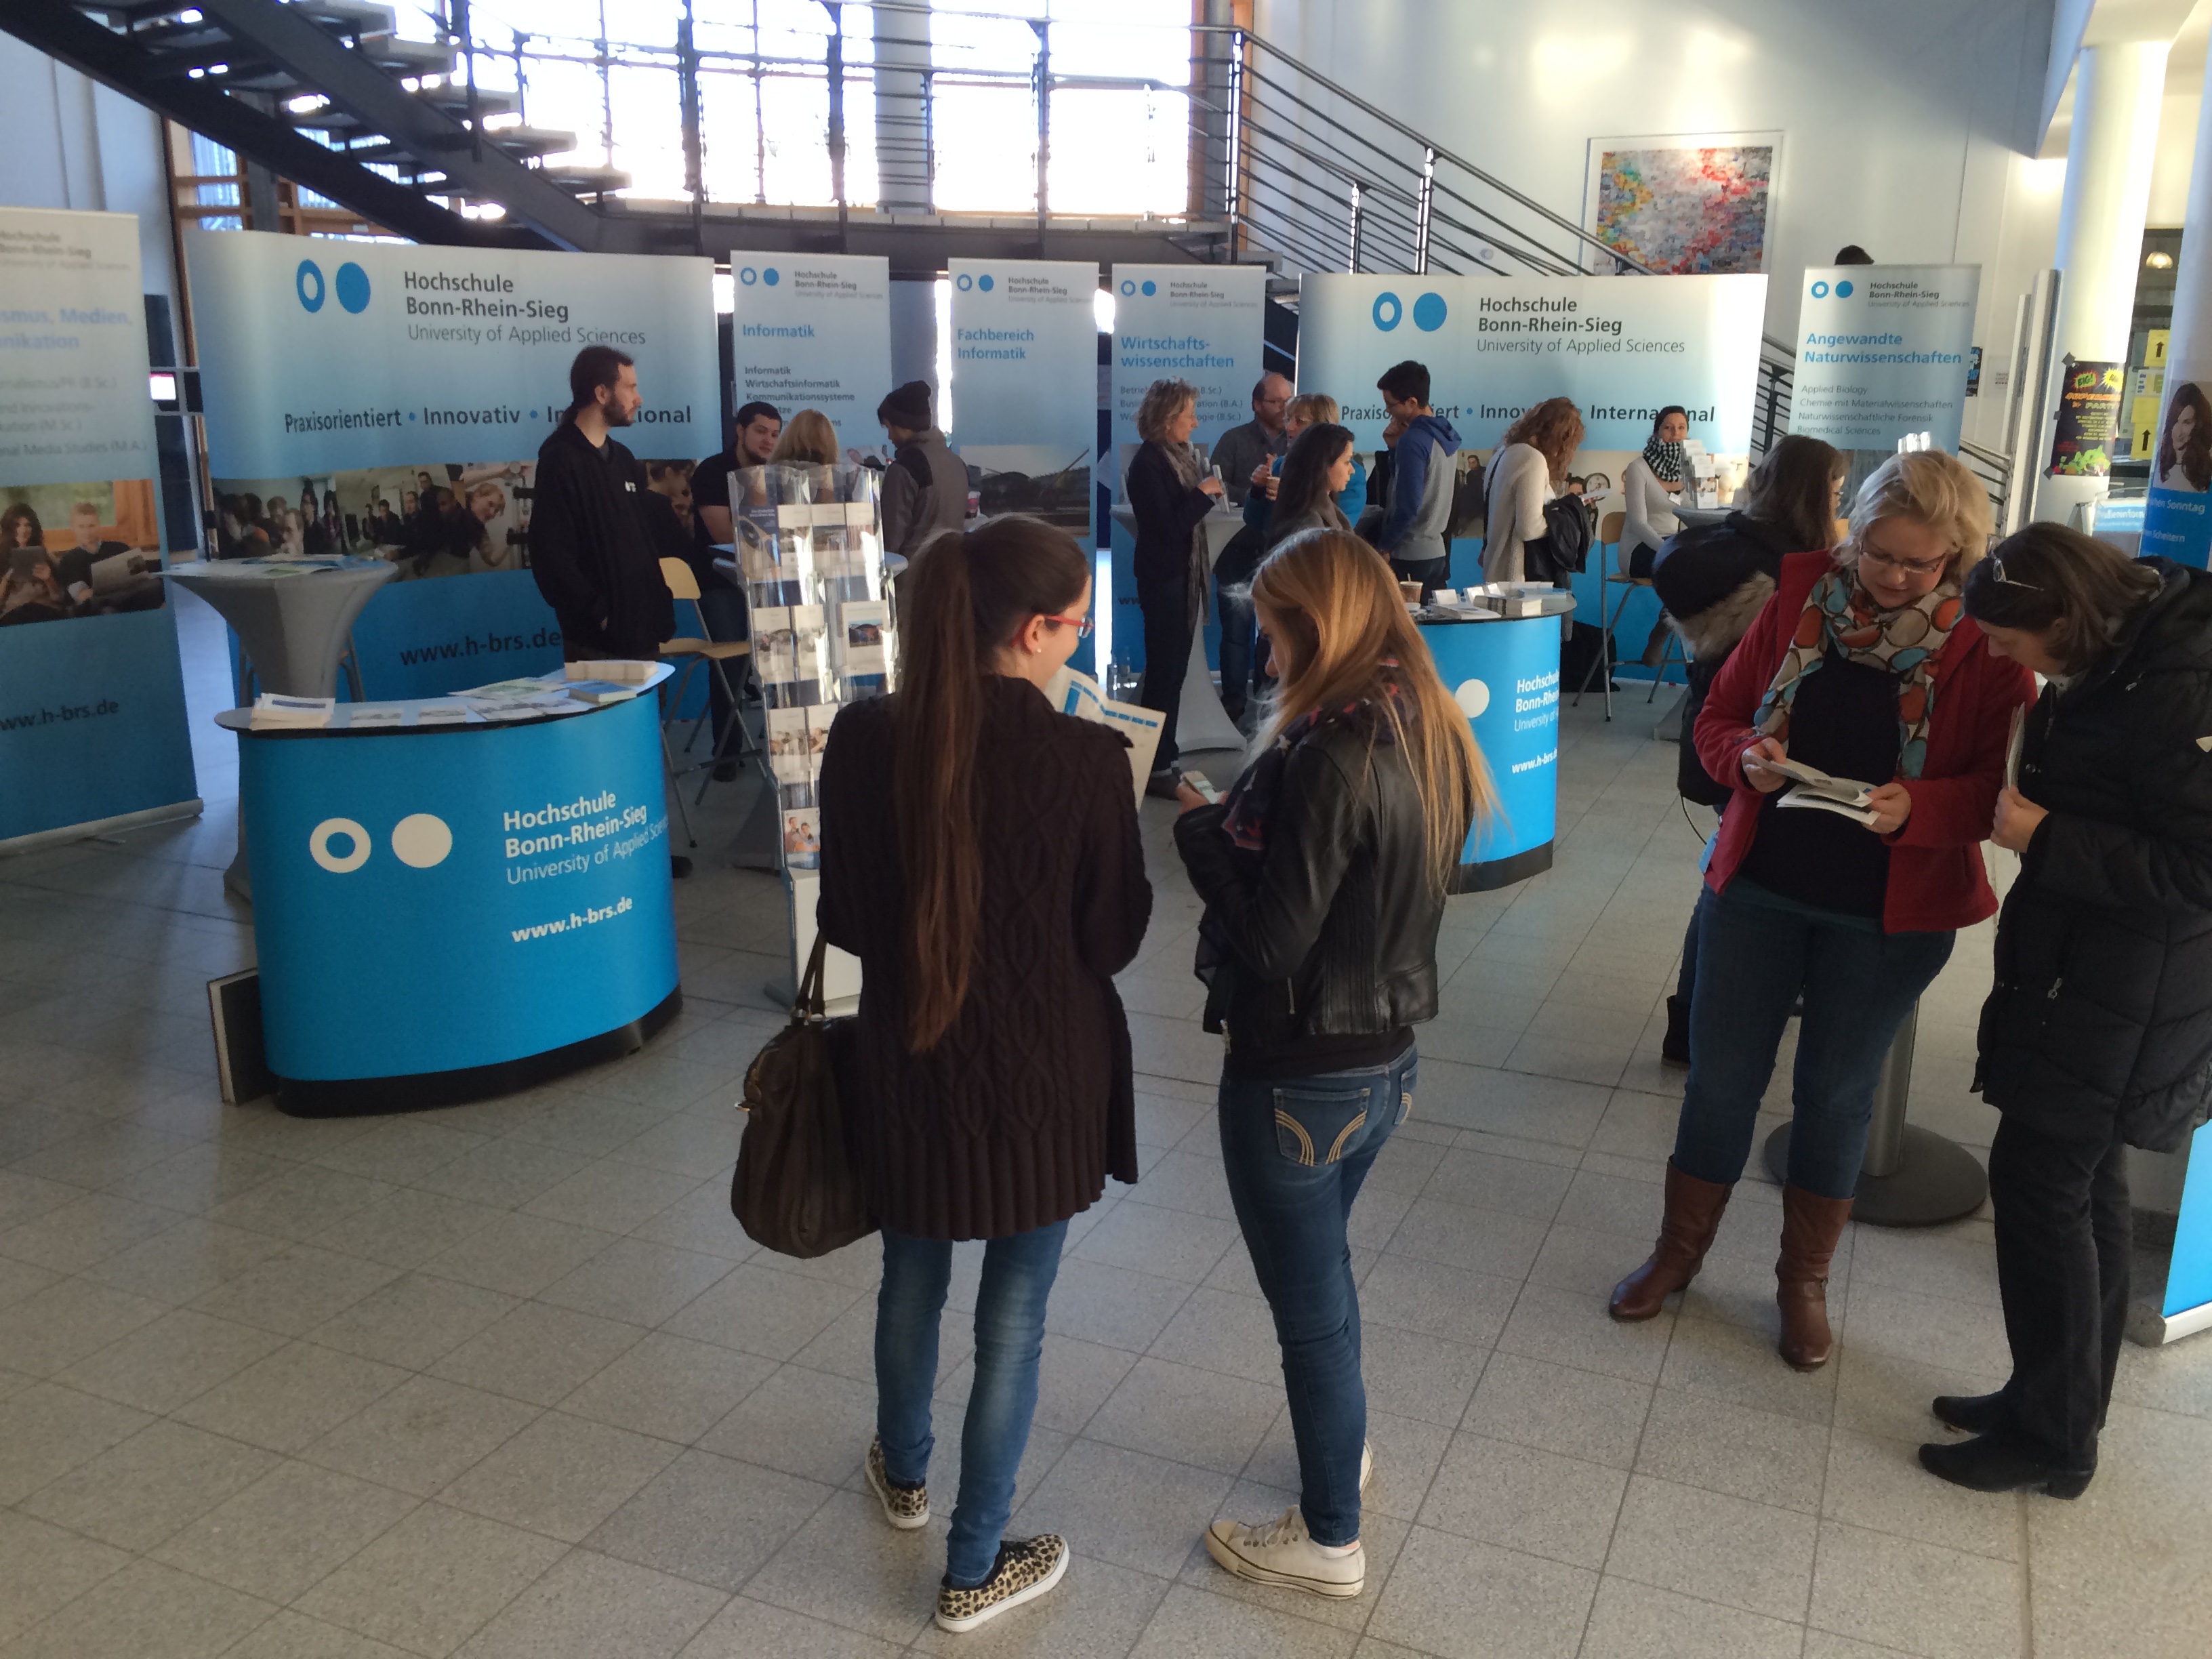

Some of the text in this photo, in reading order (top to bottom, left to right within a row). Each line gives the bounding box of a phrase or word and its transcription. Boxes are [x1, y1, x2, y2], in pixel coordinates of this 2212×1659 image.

[405, 271, 514, 292] Hochschule
[795, 271, 838, 279] Hochschule
[1008, 277, 1049, 285] Hochschule
[795, 280, 857, 291] Bonn-Rhein-Sieg
[1008, 286, 1067, 295] Bonn-Rhein-Sieg
[1870, 281, 1919, 289] Hochschule
[1170, 291, 1225, 300] Bonn-Rhein-Sieg
[1869, 291, 1940, 300] Bonn-Rhein-Sieg
[407, 297, 569, 323] Bonn-Rhein-Sieg
[1480, 297, 1578, 312] Hochschule
[0, 308, 133, 326] smus, Medien,
[743, 323, 815, 338] Informatik
[1479, 316, 1622, 336] Bonn-Rhein-Sieg
[409, 323, 646, 346] University of Applied Sciences
[958, 329, 1034, 342] Fachbereich
[1806, 333, 1902, 348] Angewandte
[1121, 336, 1210, 350] Wirtschafts-
[1477, 338, 1685, 355] University of Applied Sciences
[958, 346, 1026, 360] Informatik
[1121, 353, 1234, 368] wissenschaften
[1805, 351, 1962, 364] Naturwissenschaften
[744, 365, 792, 375] Informatik
[745, 378, 841, 388] Wirtschaftsinformatik
[2077, 373, 2093, 387] BIG!
[746, 392, 856, 403] Kommunikationssysteme
[1801, 385, 1868, 395] Applied Biology
[1800, 398, 1832, 407] Chemie
[1851, 399, 1953, 409] Materialwissenschaften
[285, 405, 691, 434] Praxisorientiert Innovativ Inional
[1341, 405, 1459, 420] Praxisoiert
[1591, 405, 1715, 422] Internanal
[1799, 412, 1933, 422] Naturwissenschaftliche Forensik
[1797, 426, 1881, 435] Biomedical Sciences
[2167, 499, 2206, 516] Sonntag
[400, 628, 562, 666] www.h-brs.de
[1517, 668, 1559, 694] Hochschul
[0, 699, 119, 731] ww.h-brs.de
[1514, 712, 1549, 732] University
[1511, 747, 1557, 774] www.h-brs.d
[504, 790, 616, 832] Hochschule
[506, 805, 647, 859] Bonn-Rhein-Sieg
[507, 853, 590, 884] University
[594, 844, 609, 865] of
[613, 826, 649, 859] Applied
[512, 897, 633, 943] www.h-brs.de
